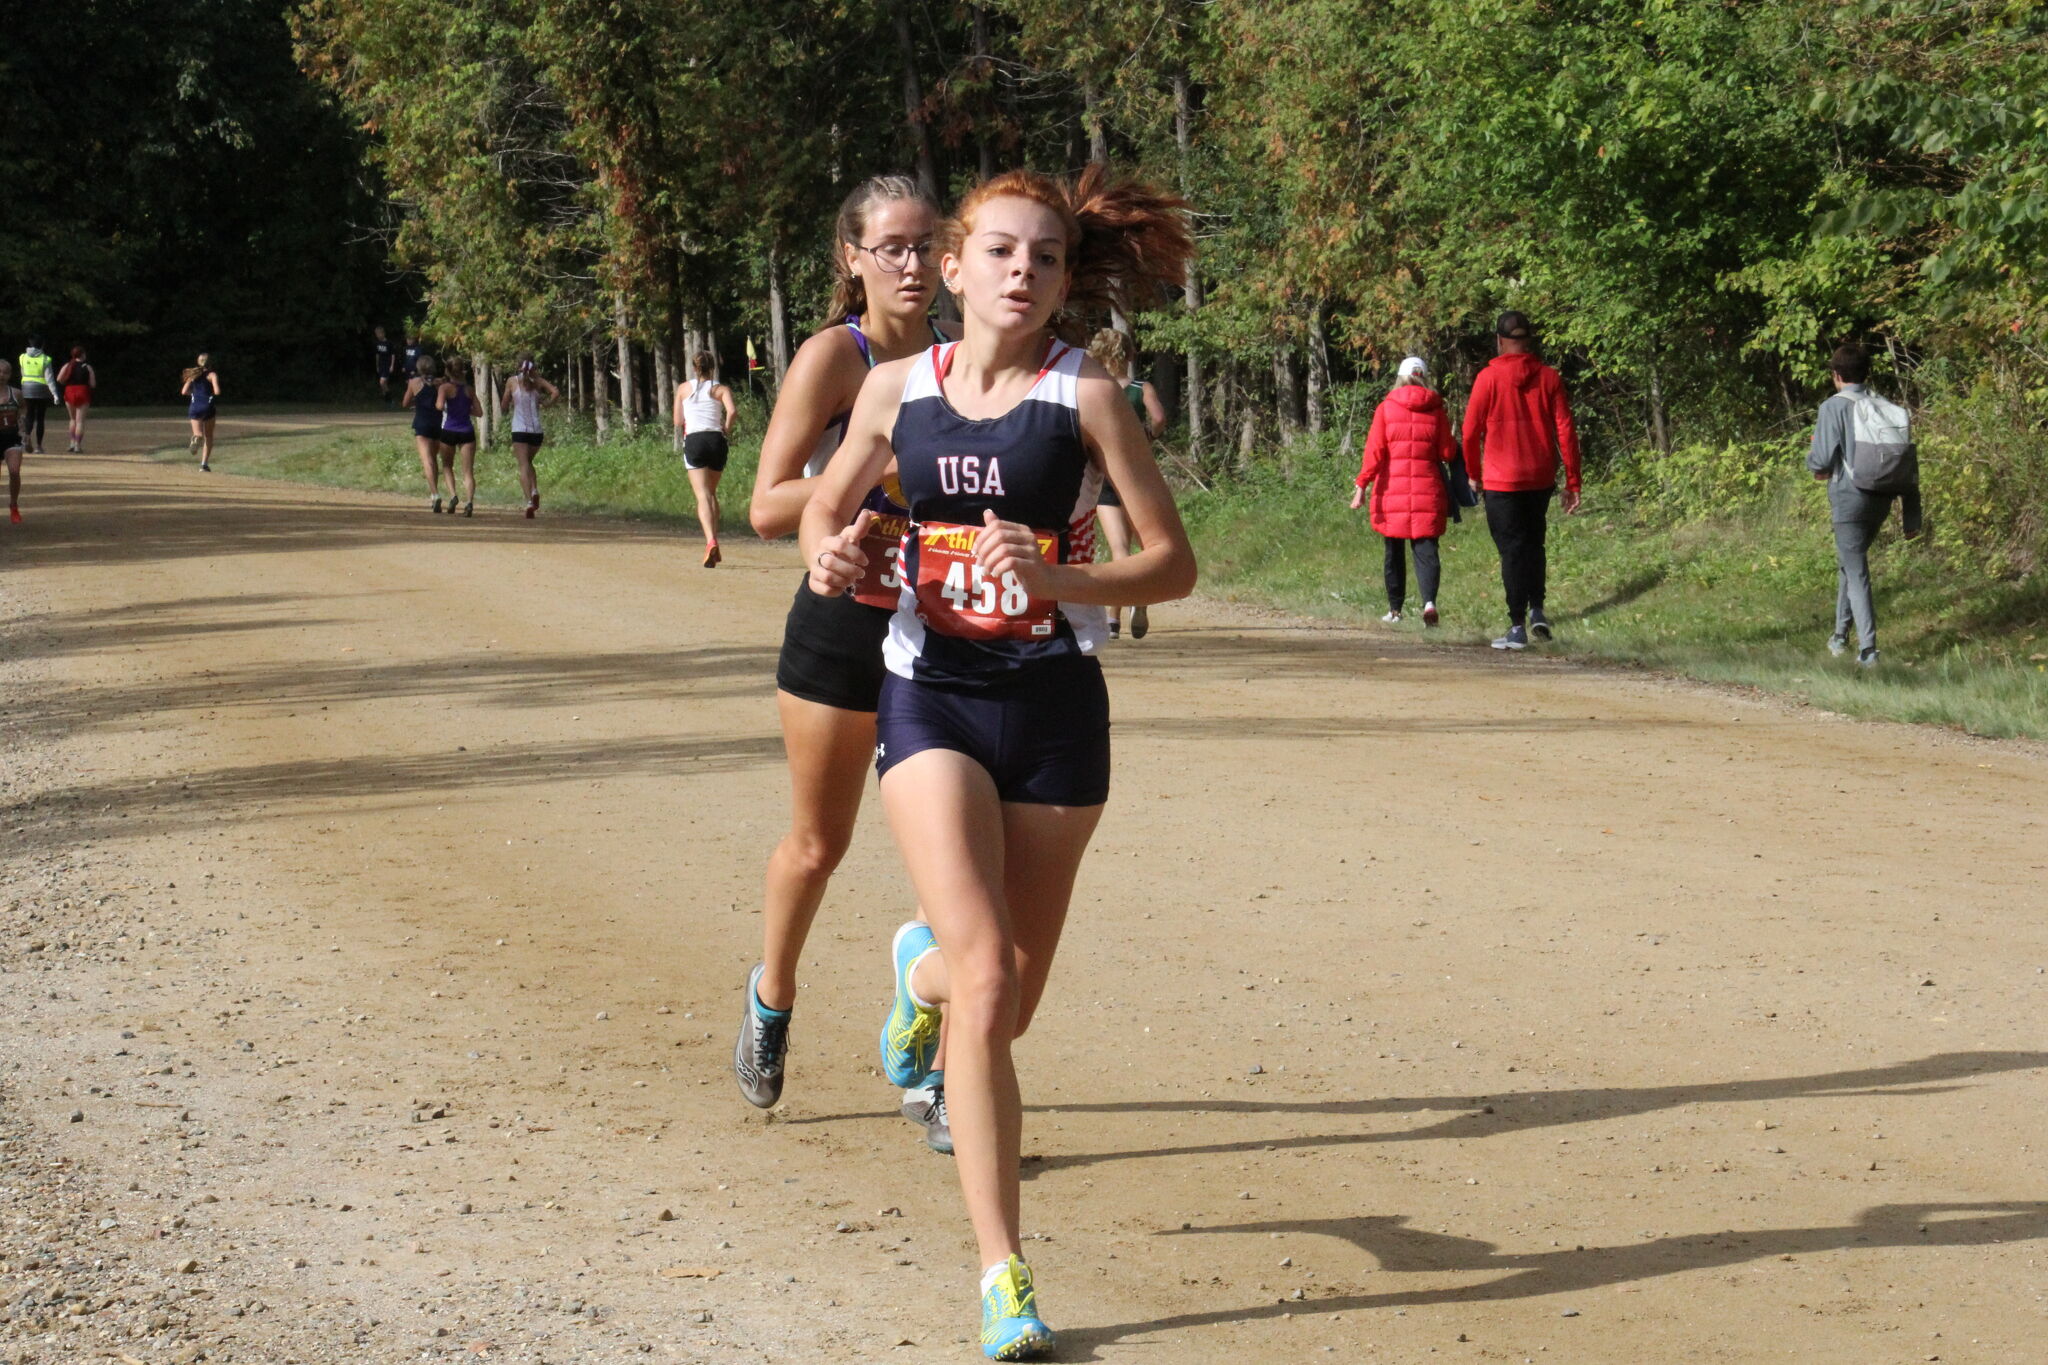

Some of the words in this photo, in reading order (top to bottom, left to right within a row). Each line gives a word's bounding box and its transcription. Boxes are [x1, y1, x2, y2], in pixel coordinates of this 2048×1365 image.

[937, 456, 1005, 496] USA
[871, 516, 907, 537] Athl
[924, 527, 975, 552] Athl
[880, 547, 901, 588] 3
[941, 561, 1029, 616] 458
